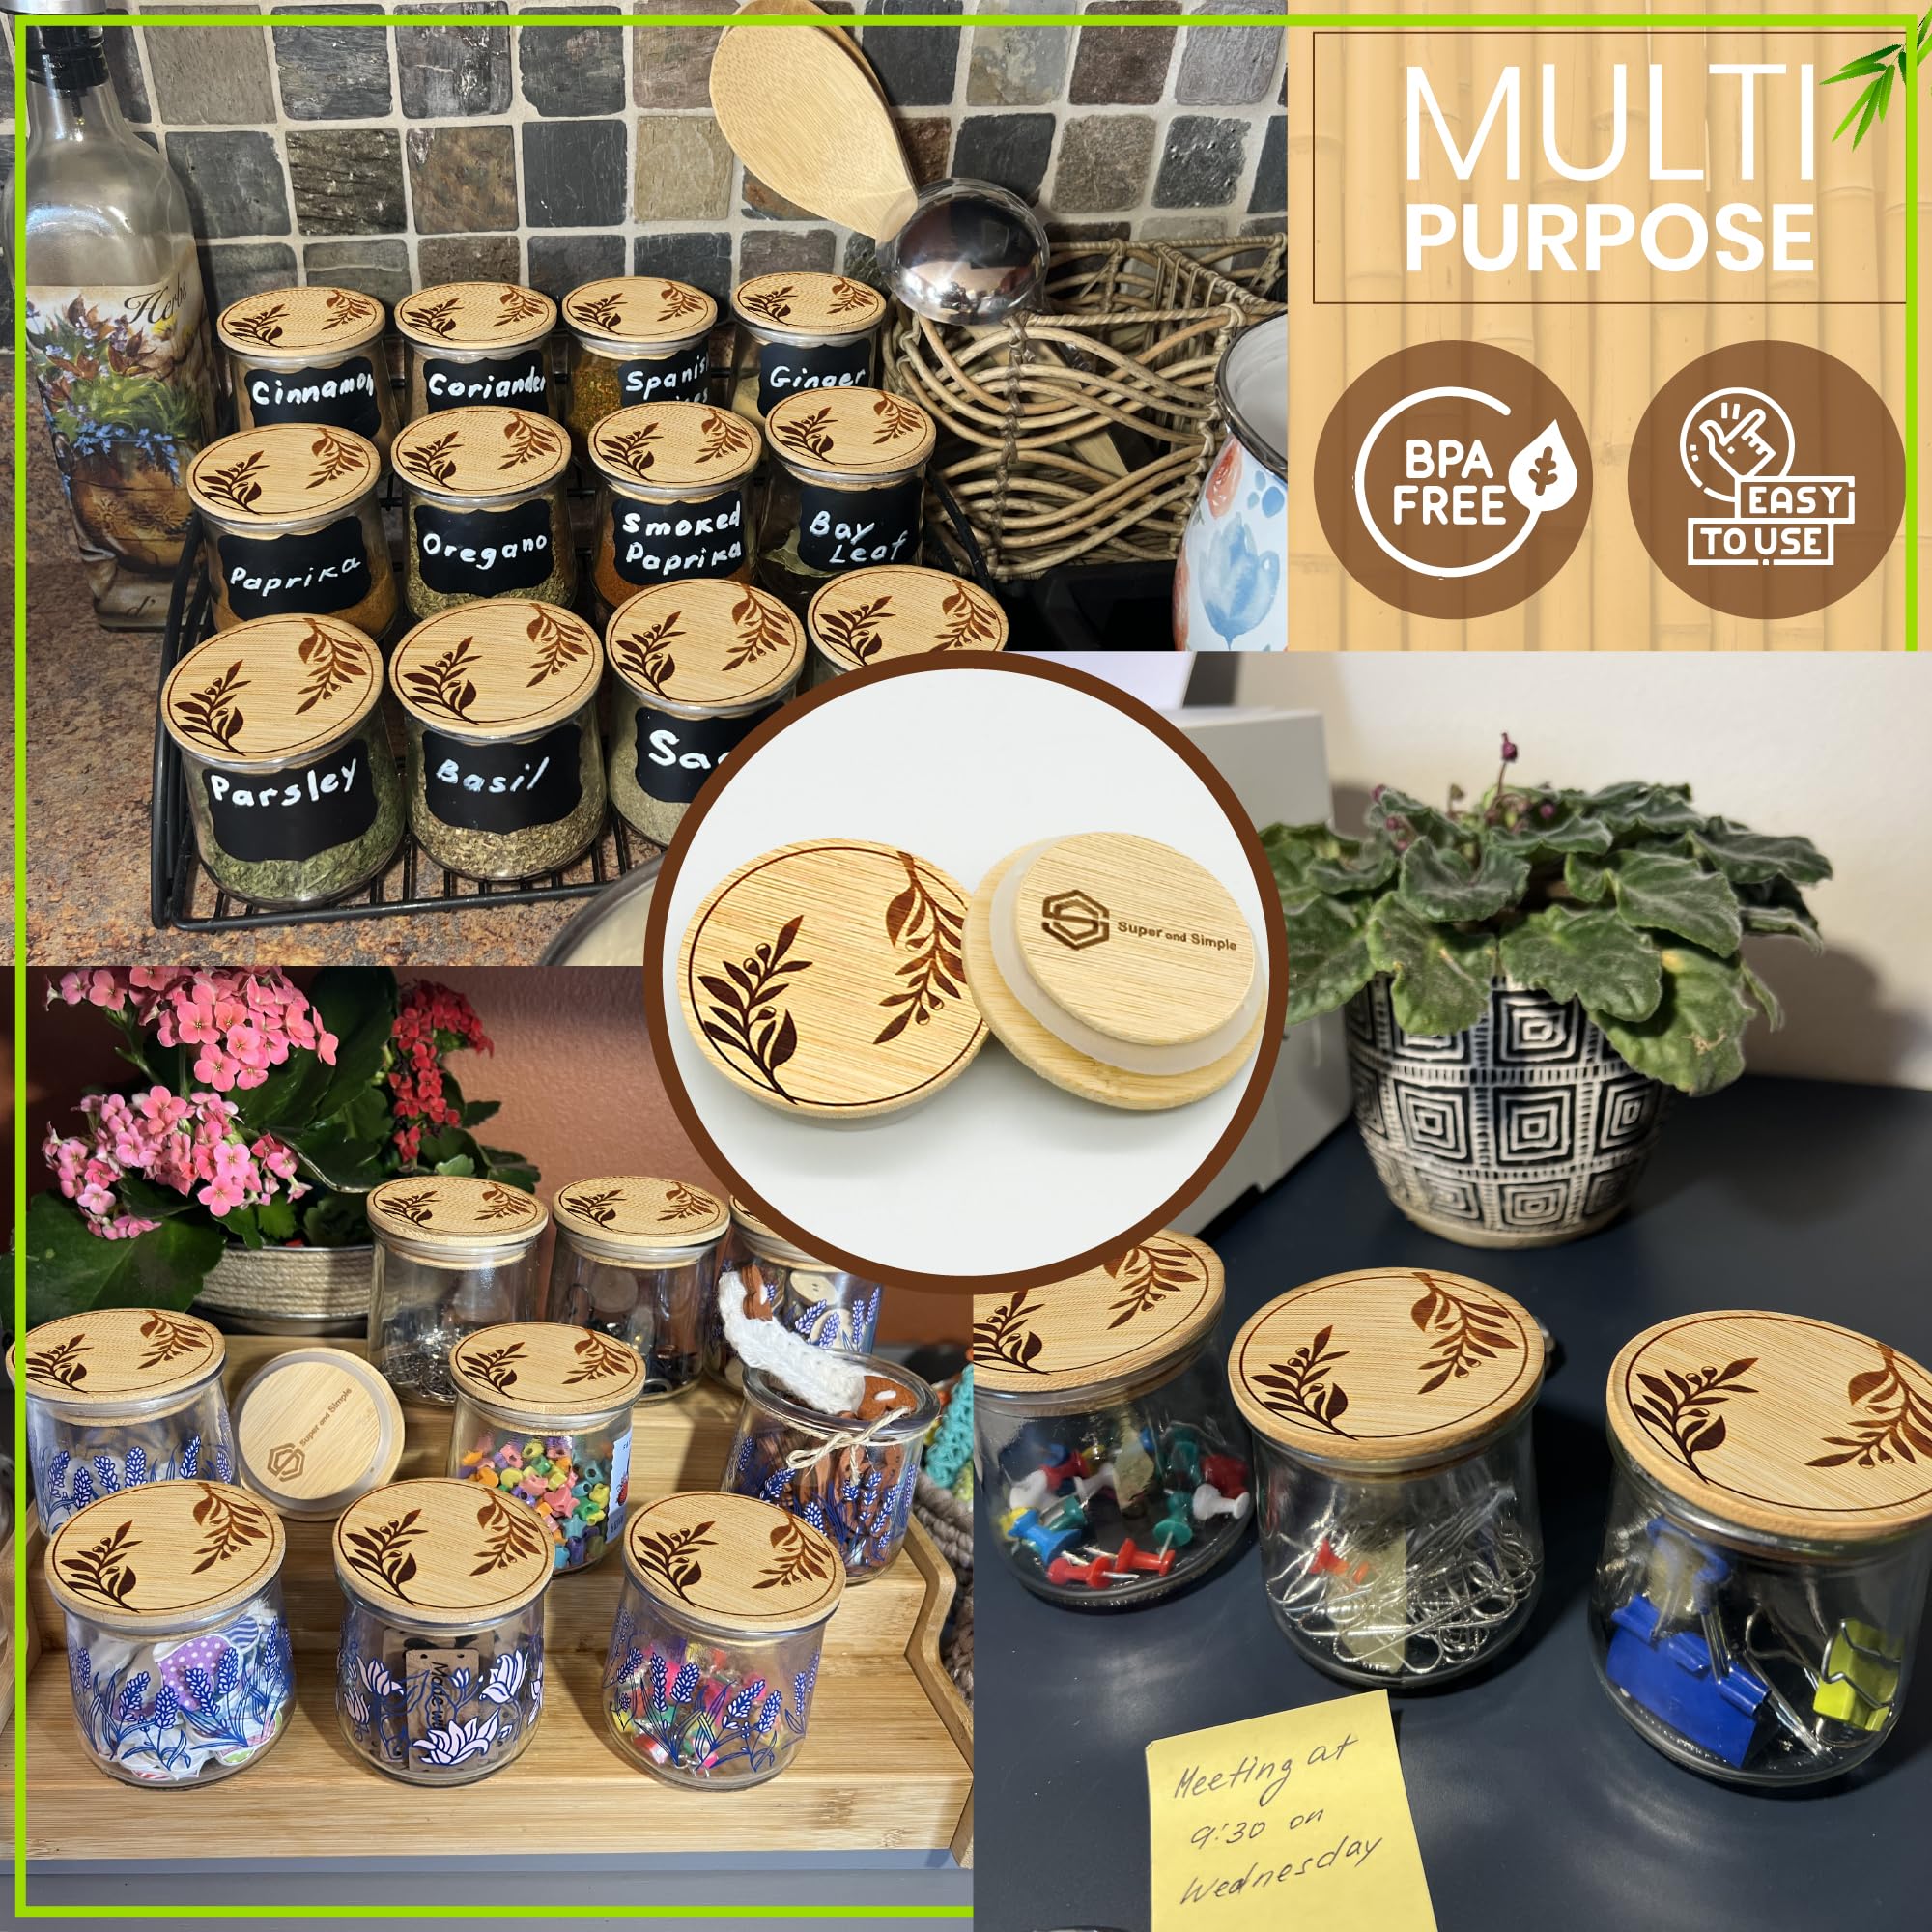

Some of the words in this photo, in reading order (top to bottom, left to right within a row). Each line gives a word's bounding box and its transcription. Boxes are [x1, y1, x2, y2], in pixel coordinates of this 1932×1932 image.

[124, 272, 187, 324] Herbs
[252, 372, 375, 406] Cinnamon
[428, 365, 547, 399] Coriander
[622, 500, 742, 538] Smoked
[809, 510, 875, 546] Bay
[422, 532, 548, 570] Oregano
[625, 540, 742, 576] Paprika
[828, 530, 909, 564] Leaf
[230, 556, 361, 597] Paprika
[648, 729, 730, 769] Sa
[209, 757, 357, 808] Parsley
[435, 756, 551, 793] Basil
[1117, 922, 1163, 937] Super
[1165, 932, 1187, 942] and
[1191, 933, 1237, 951] Simple
[299, 1424, 320, 1447] Super
[1173, 1756, 1293, 1807] Meeting
[1306, 1733, 1359, 1766] at
[1191, 1822, 1265, 1850] 9:30
[1290, 1809, 1324, 1830] on
[1179, 1835, 1383, 1906] Wednesday
